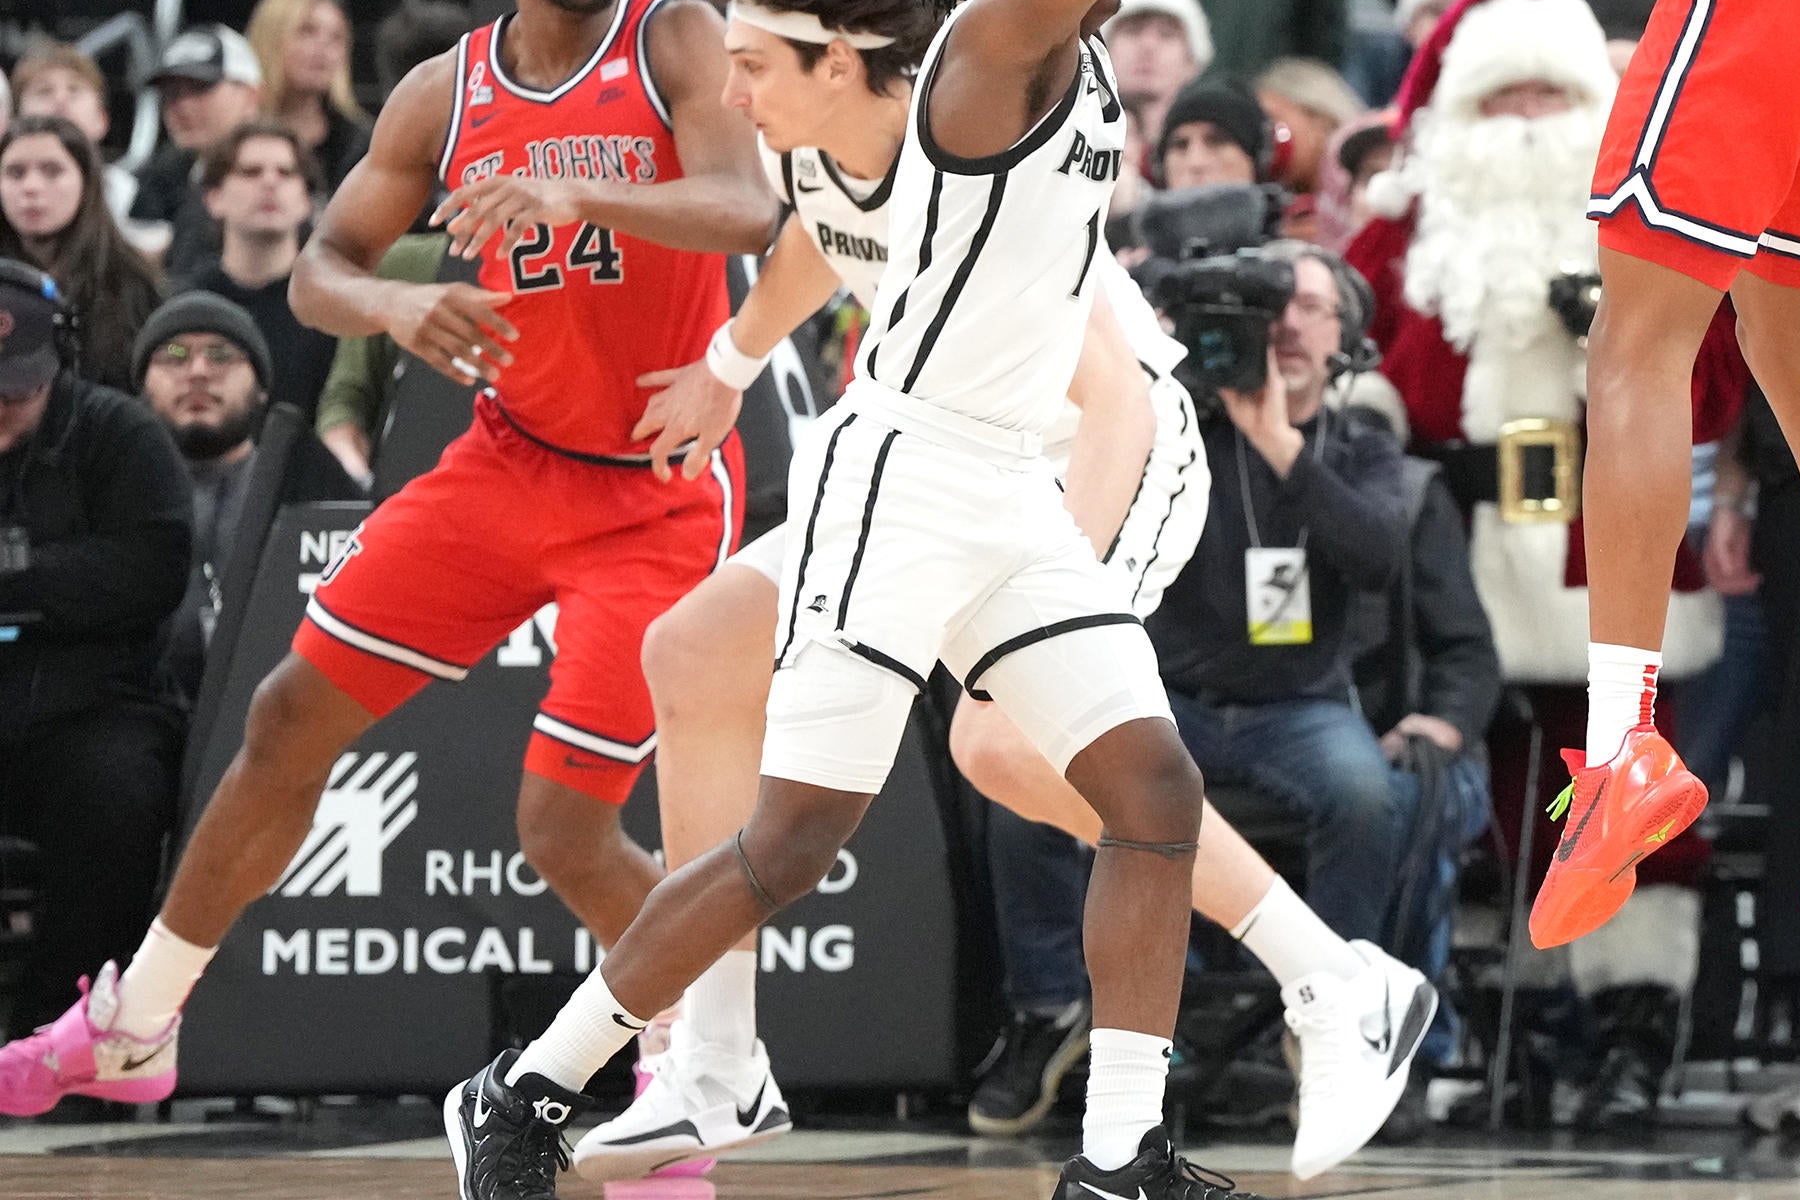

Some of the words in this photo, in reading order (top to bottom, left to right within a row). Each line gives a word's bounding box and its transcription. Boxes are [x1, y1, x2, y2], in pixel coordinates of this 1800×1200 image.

[506, 219, 624, 295] 24
[424, 849, 549, 897] RHO
[262, 926, 554, 976] MEDICAL
